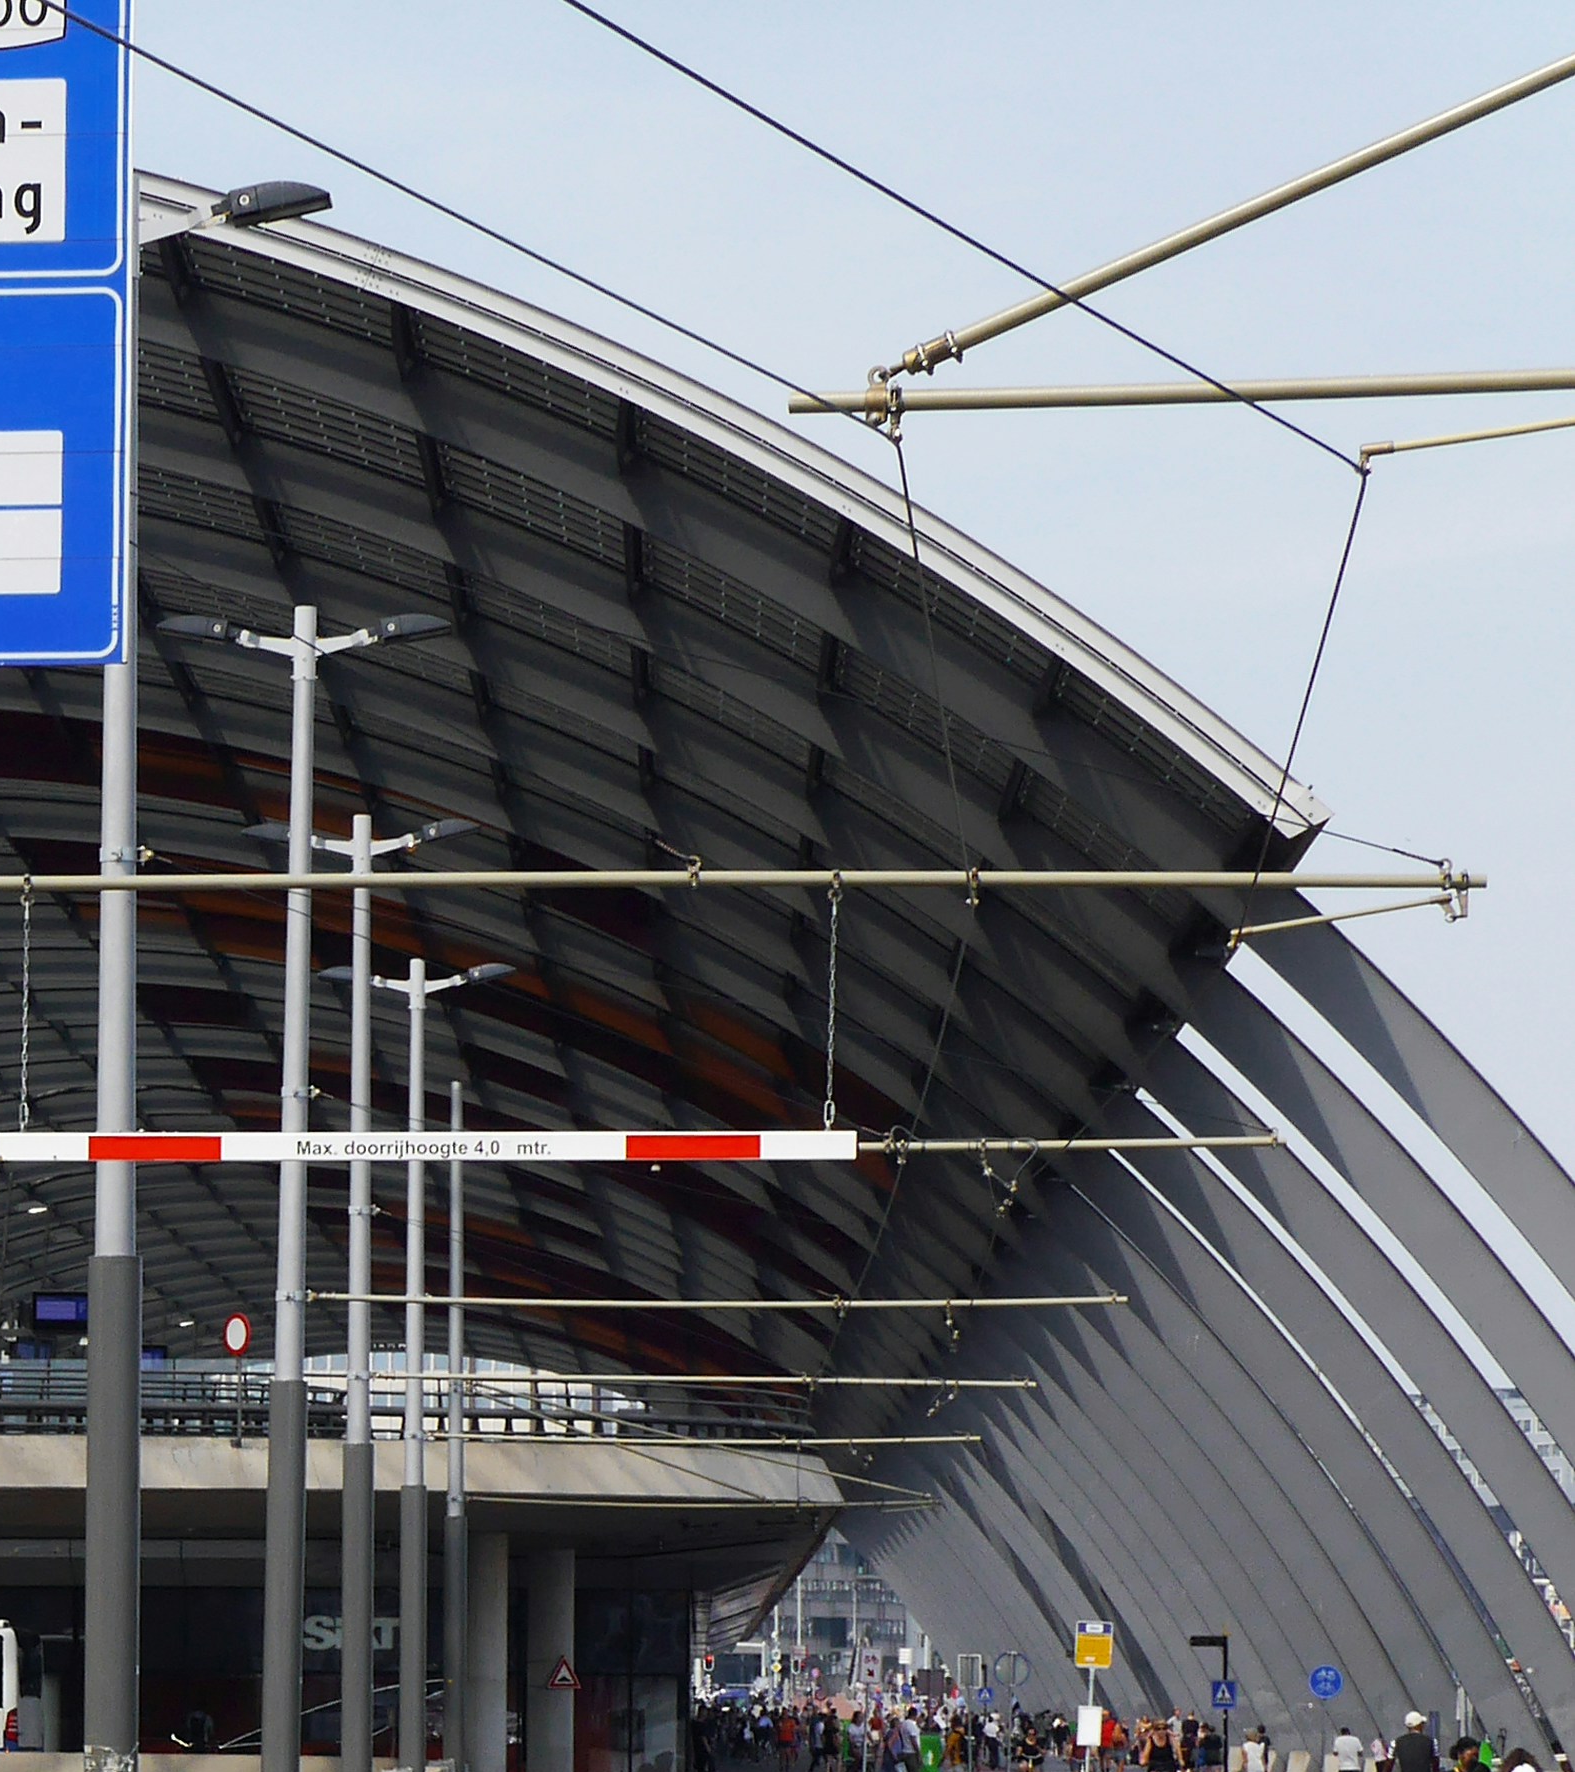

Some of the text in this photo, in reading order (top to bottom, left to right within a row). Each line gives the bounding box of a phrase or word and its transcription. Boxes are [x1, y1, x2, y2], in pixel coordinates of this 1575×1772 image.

[297, 1139, 552, 1158] Max. doorrijhoogte 4,0 mtr.
